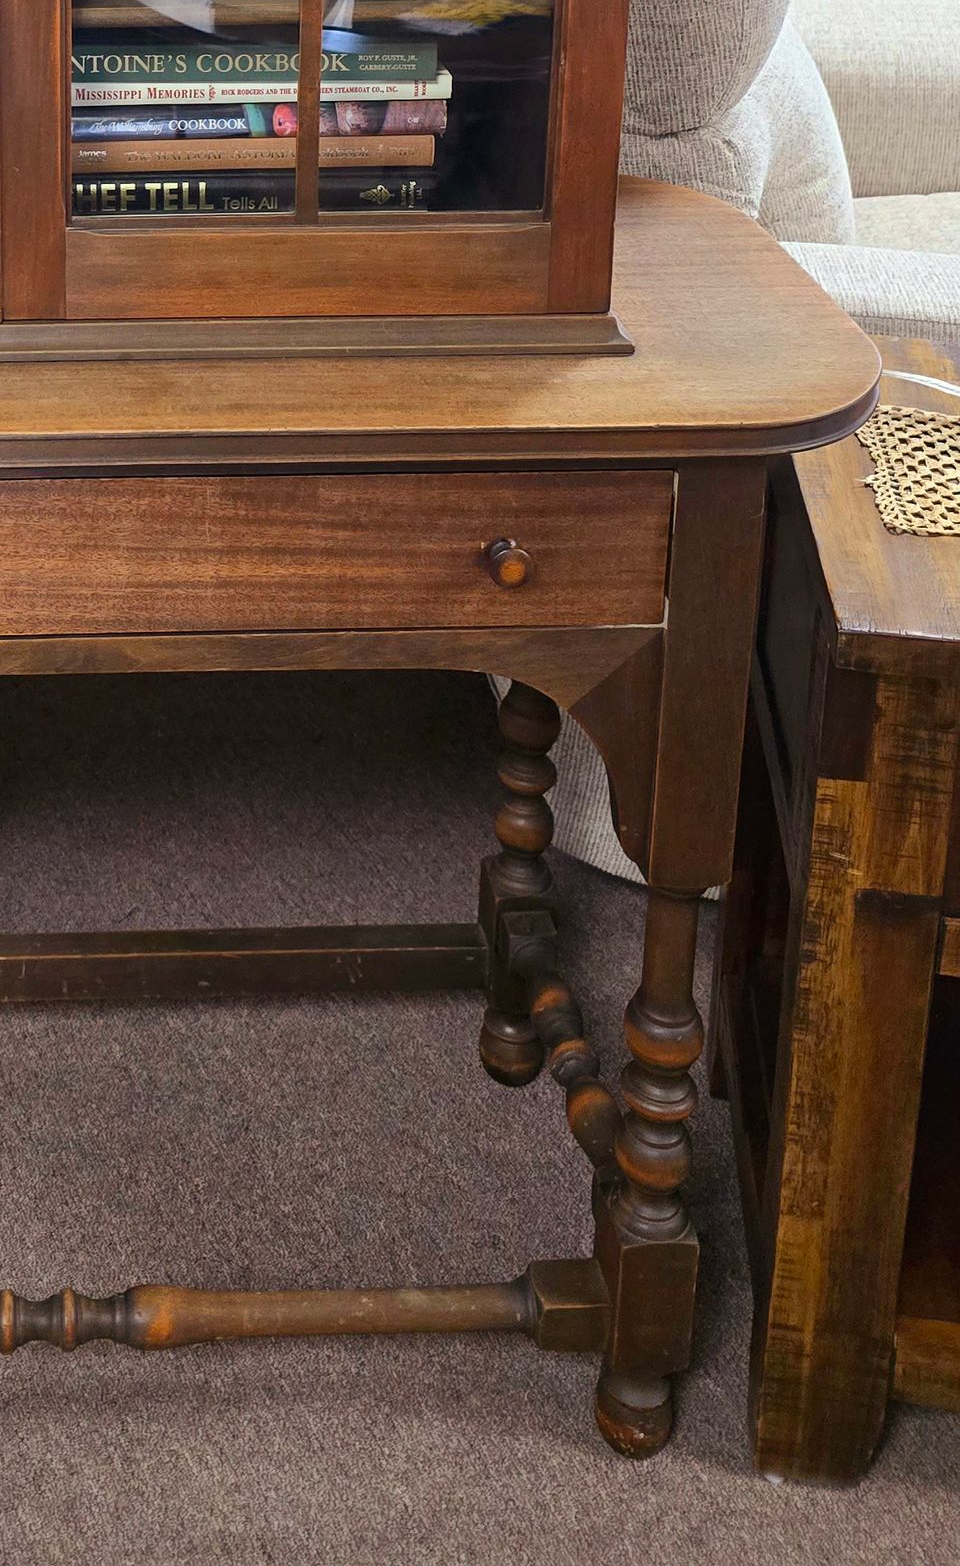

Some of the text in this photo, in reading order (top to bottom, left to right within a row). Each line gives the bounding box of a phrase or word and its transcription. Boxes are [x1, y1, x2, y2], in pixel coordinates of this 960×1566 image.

[71, 54, 187, 74] NTOINE'S
[358, 54, 374, 62] ROY
[407, 54, 418, 62] JR.
[75, 88, 142, 101] MISSISSIPPI
[146, 87, 205, 100] MEMORIES
[237, 88, 265, 96] RODGERS
[334, 86, 371, 94] STEAMBOAT
[168, 118, 247, 131] COOKBOOK
[154, 150, 224, 161] WALDORF
[319, 147, 370, 158] okbook
[75, 181, 278, 213] HEF TELL Tells All
